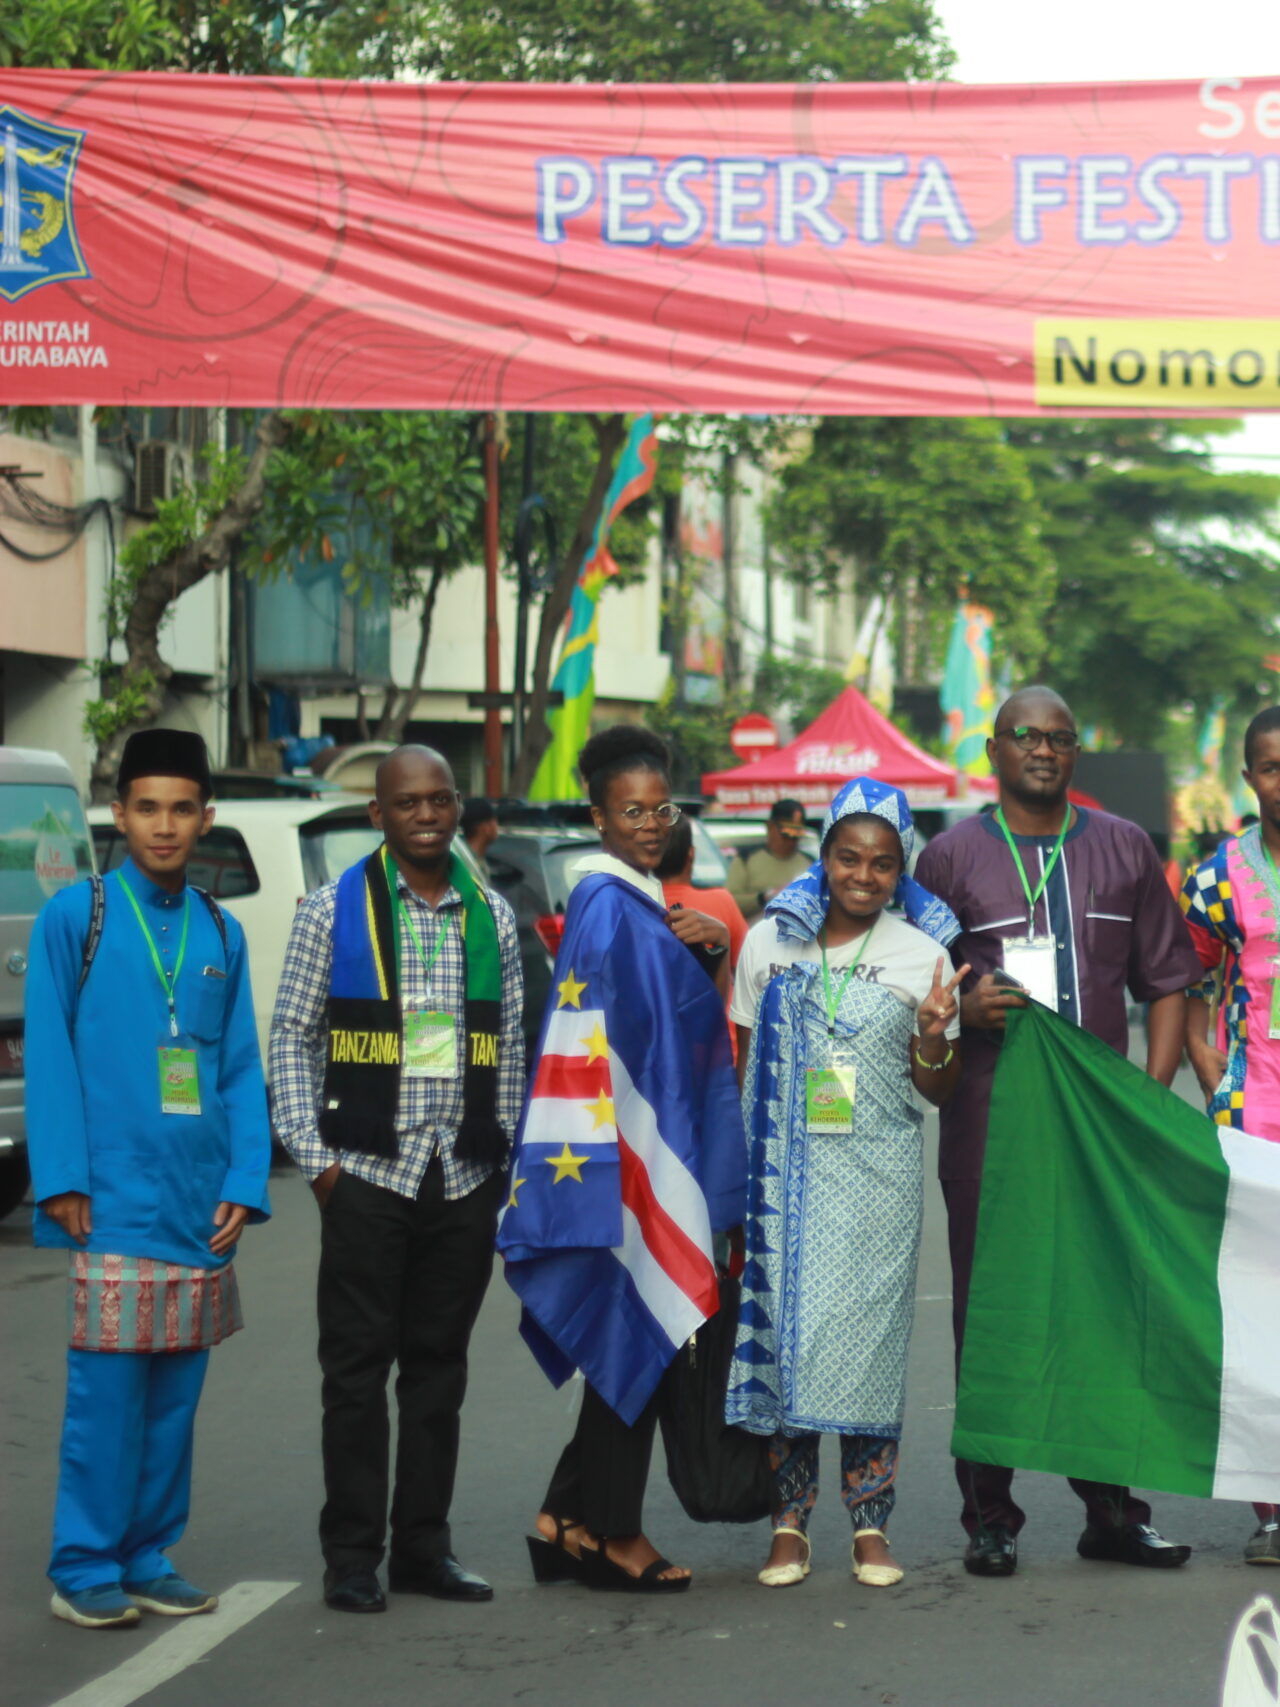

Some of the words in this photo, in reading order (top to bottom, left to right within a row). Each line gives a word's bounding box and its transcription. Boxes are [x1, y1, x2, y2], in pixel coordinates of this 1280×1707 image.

[537, 156, 976, 246] PESERTA
[0, 320, 90, 343] RINTAH
[331, 1030, 400, 1065] TANZANIA
